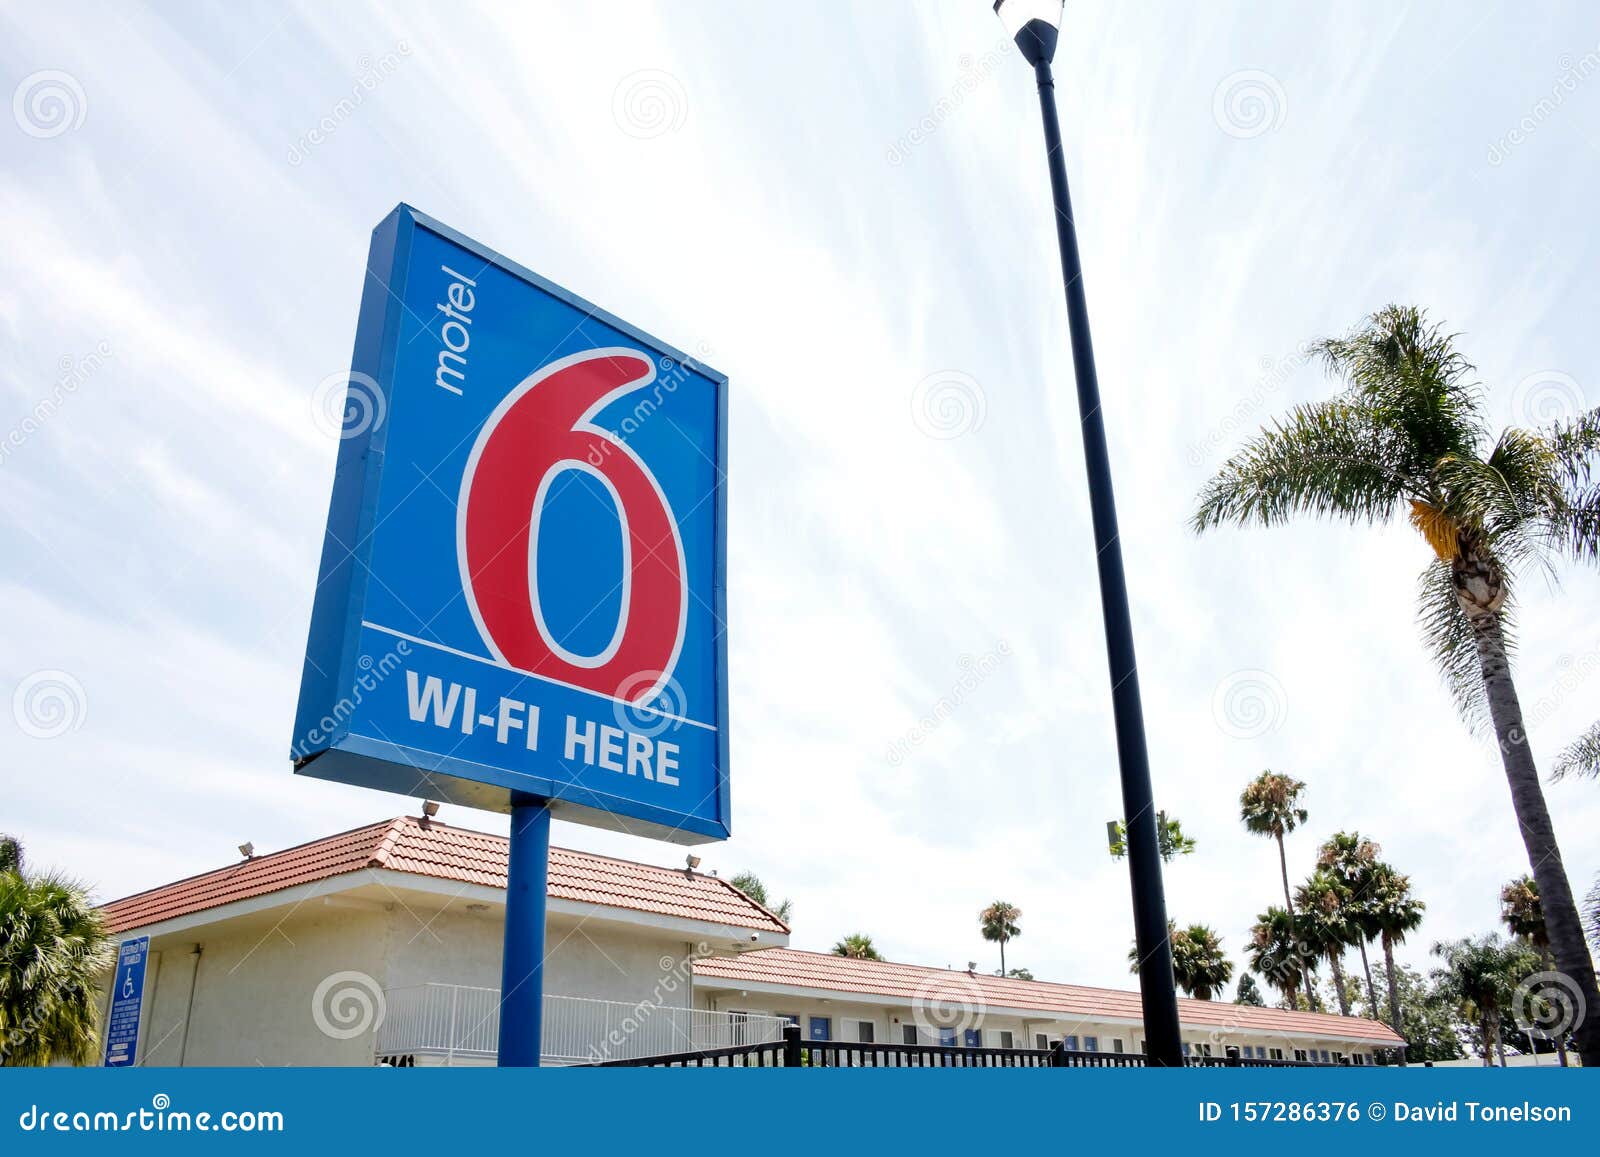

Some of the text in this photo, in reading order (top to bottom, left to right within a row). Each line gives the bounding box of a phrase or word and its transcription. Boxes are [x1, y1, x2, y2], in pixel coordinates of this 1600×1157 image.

[436, 265, 476, 396] motel
[456, 346, 689, 707] 6
[406, 670, 681, 787] WI-FI HERE
